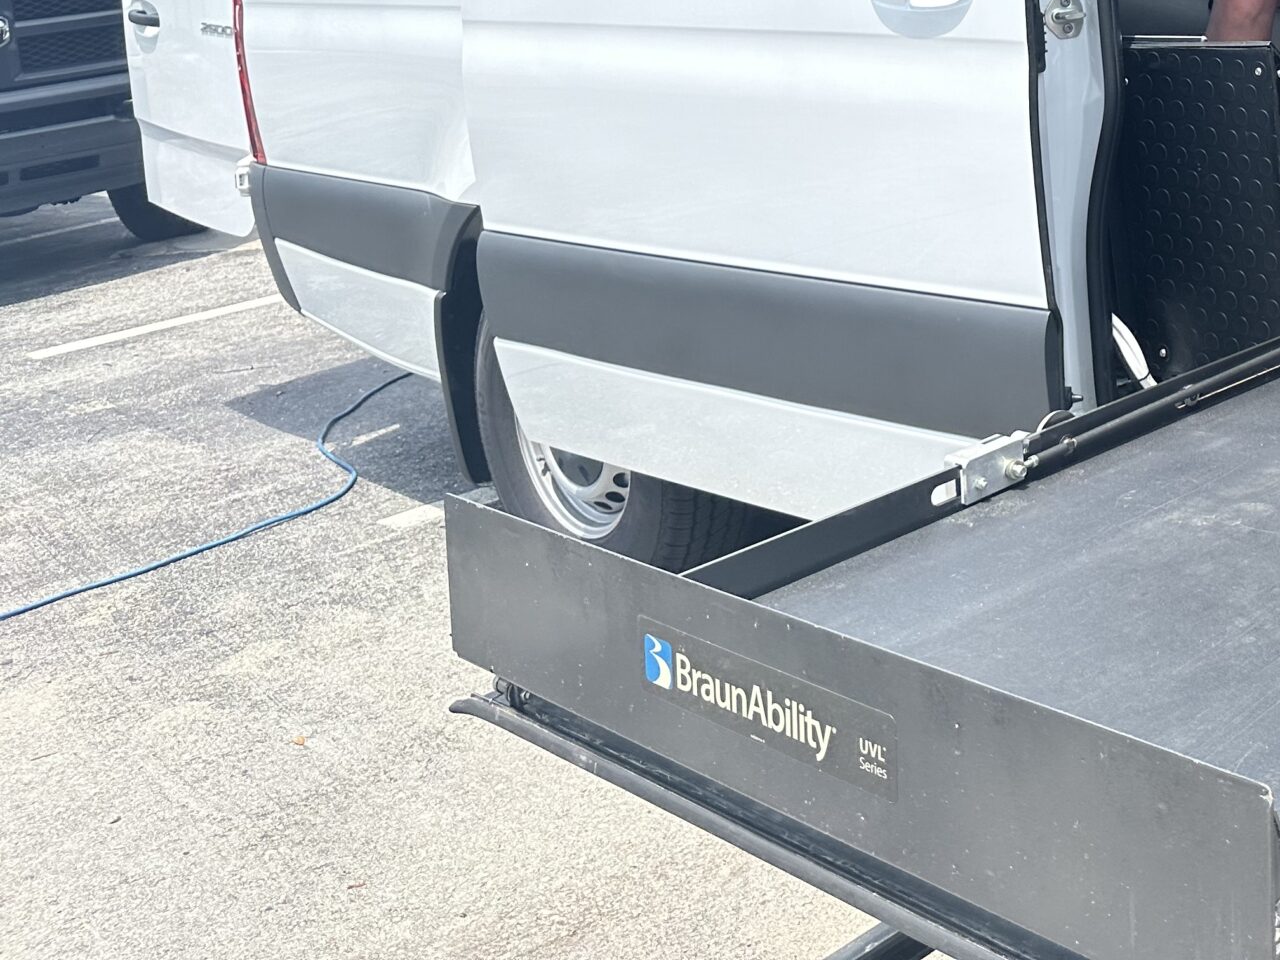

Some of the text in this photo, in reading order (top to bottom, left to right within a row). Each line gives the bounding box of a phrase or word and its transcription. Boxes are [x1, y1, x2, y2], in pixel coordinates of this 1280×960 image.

[675, 652, 834, 762] BraunAbility
[859, 737, 885, 762] UVL
[859, 756, 887, 779] Series
